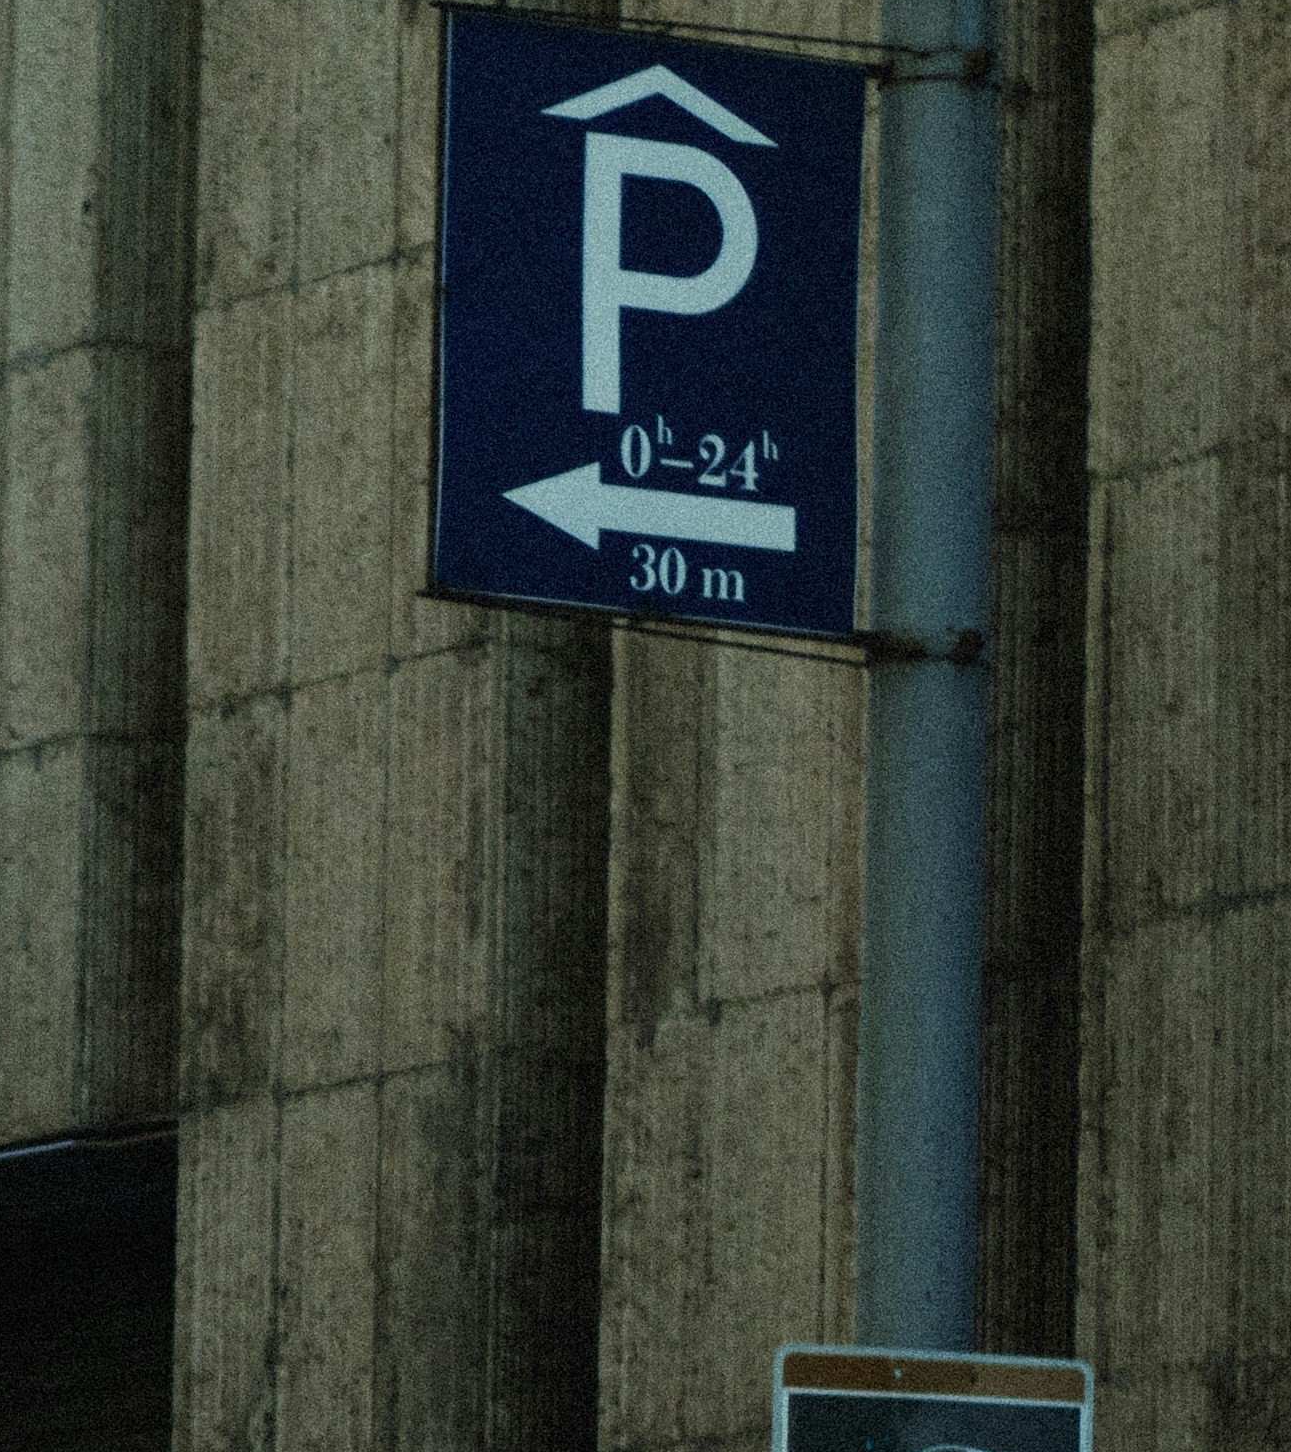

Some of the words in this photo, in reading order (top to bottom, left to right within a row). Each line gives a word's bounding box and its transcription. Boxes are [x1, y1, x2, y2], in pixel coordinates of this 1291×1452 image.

[582, 130, 759, 415] P
[629, 544, 687, 595] 30
[700, 564, 746, 604] m
